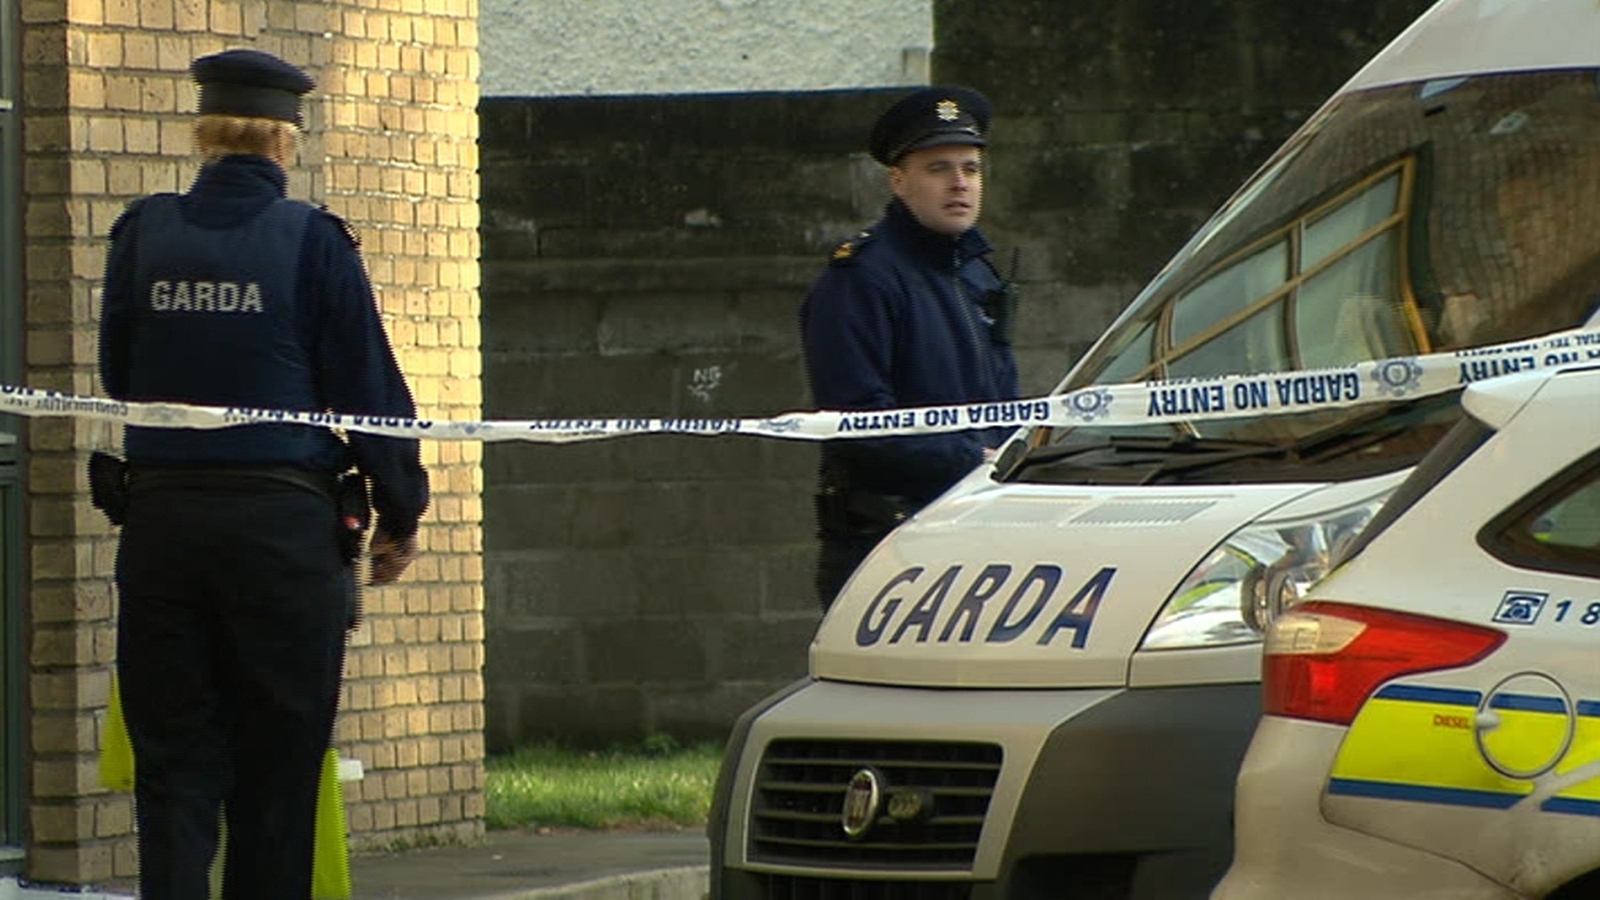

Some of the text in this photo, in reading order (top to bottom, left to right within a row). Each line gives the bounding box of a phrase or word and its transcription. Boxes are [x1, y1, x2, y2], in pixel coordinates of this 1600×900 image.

[150, 281, 263, 312] GARDA
[1459, 356, 1535, 383] ENTRY
[1147, 385, 1226, 417] ENTRY
[1233, 380, 1268, 410] NO
[1275, 372, 1360, 407] GARDA
[838, 401, 1050, 432] GARDA NO ENTRY
[855, 564, 1118, 649] GARDA
